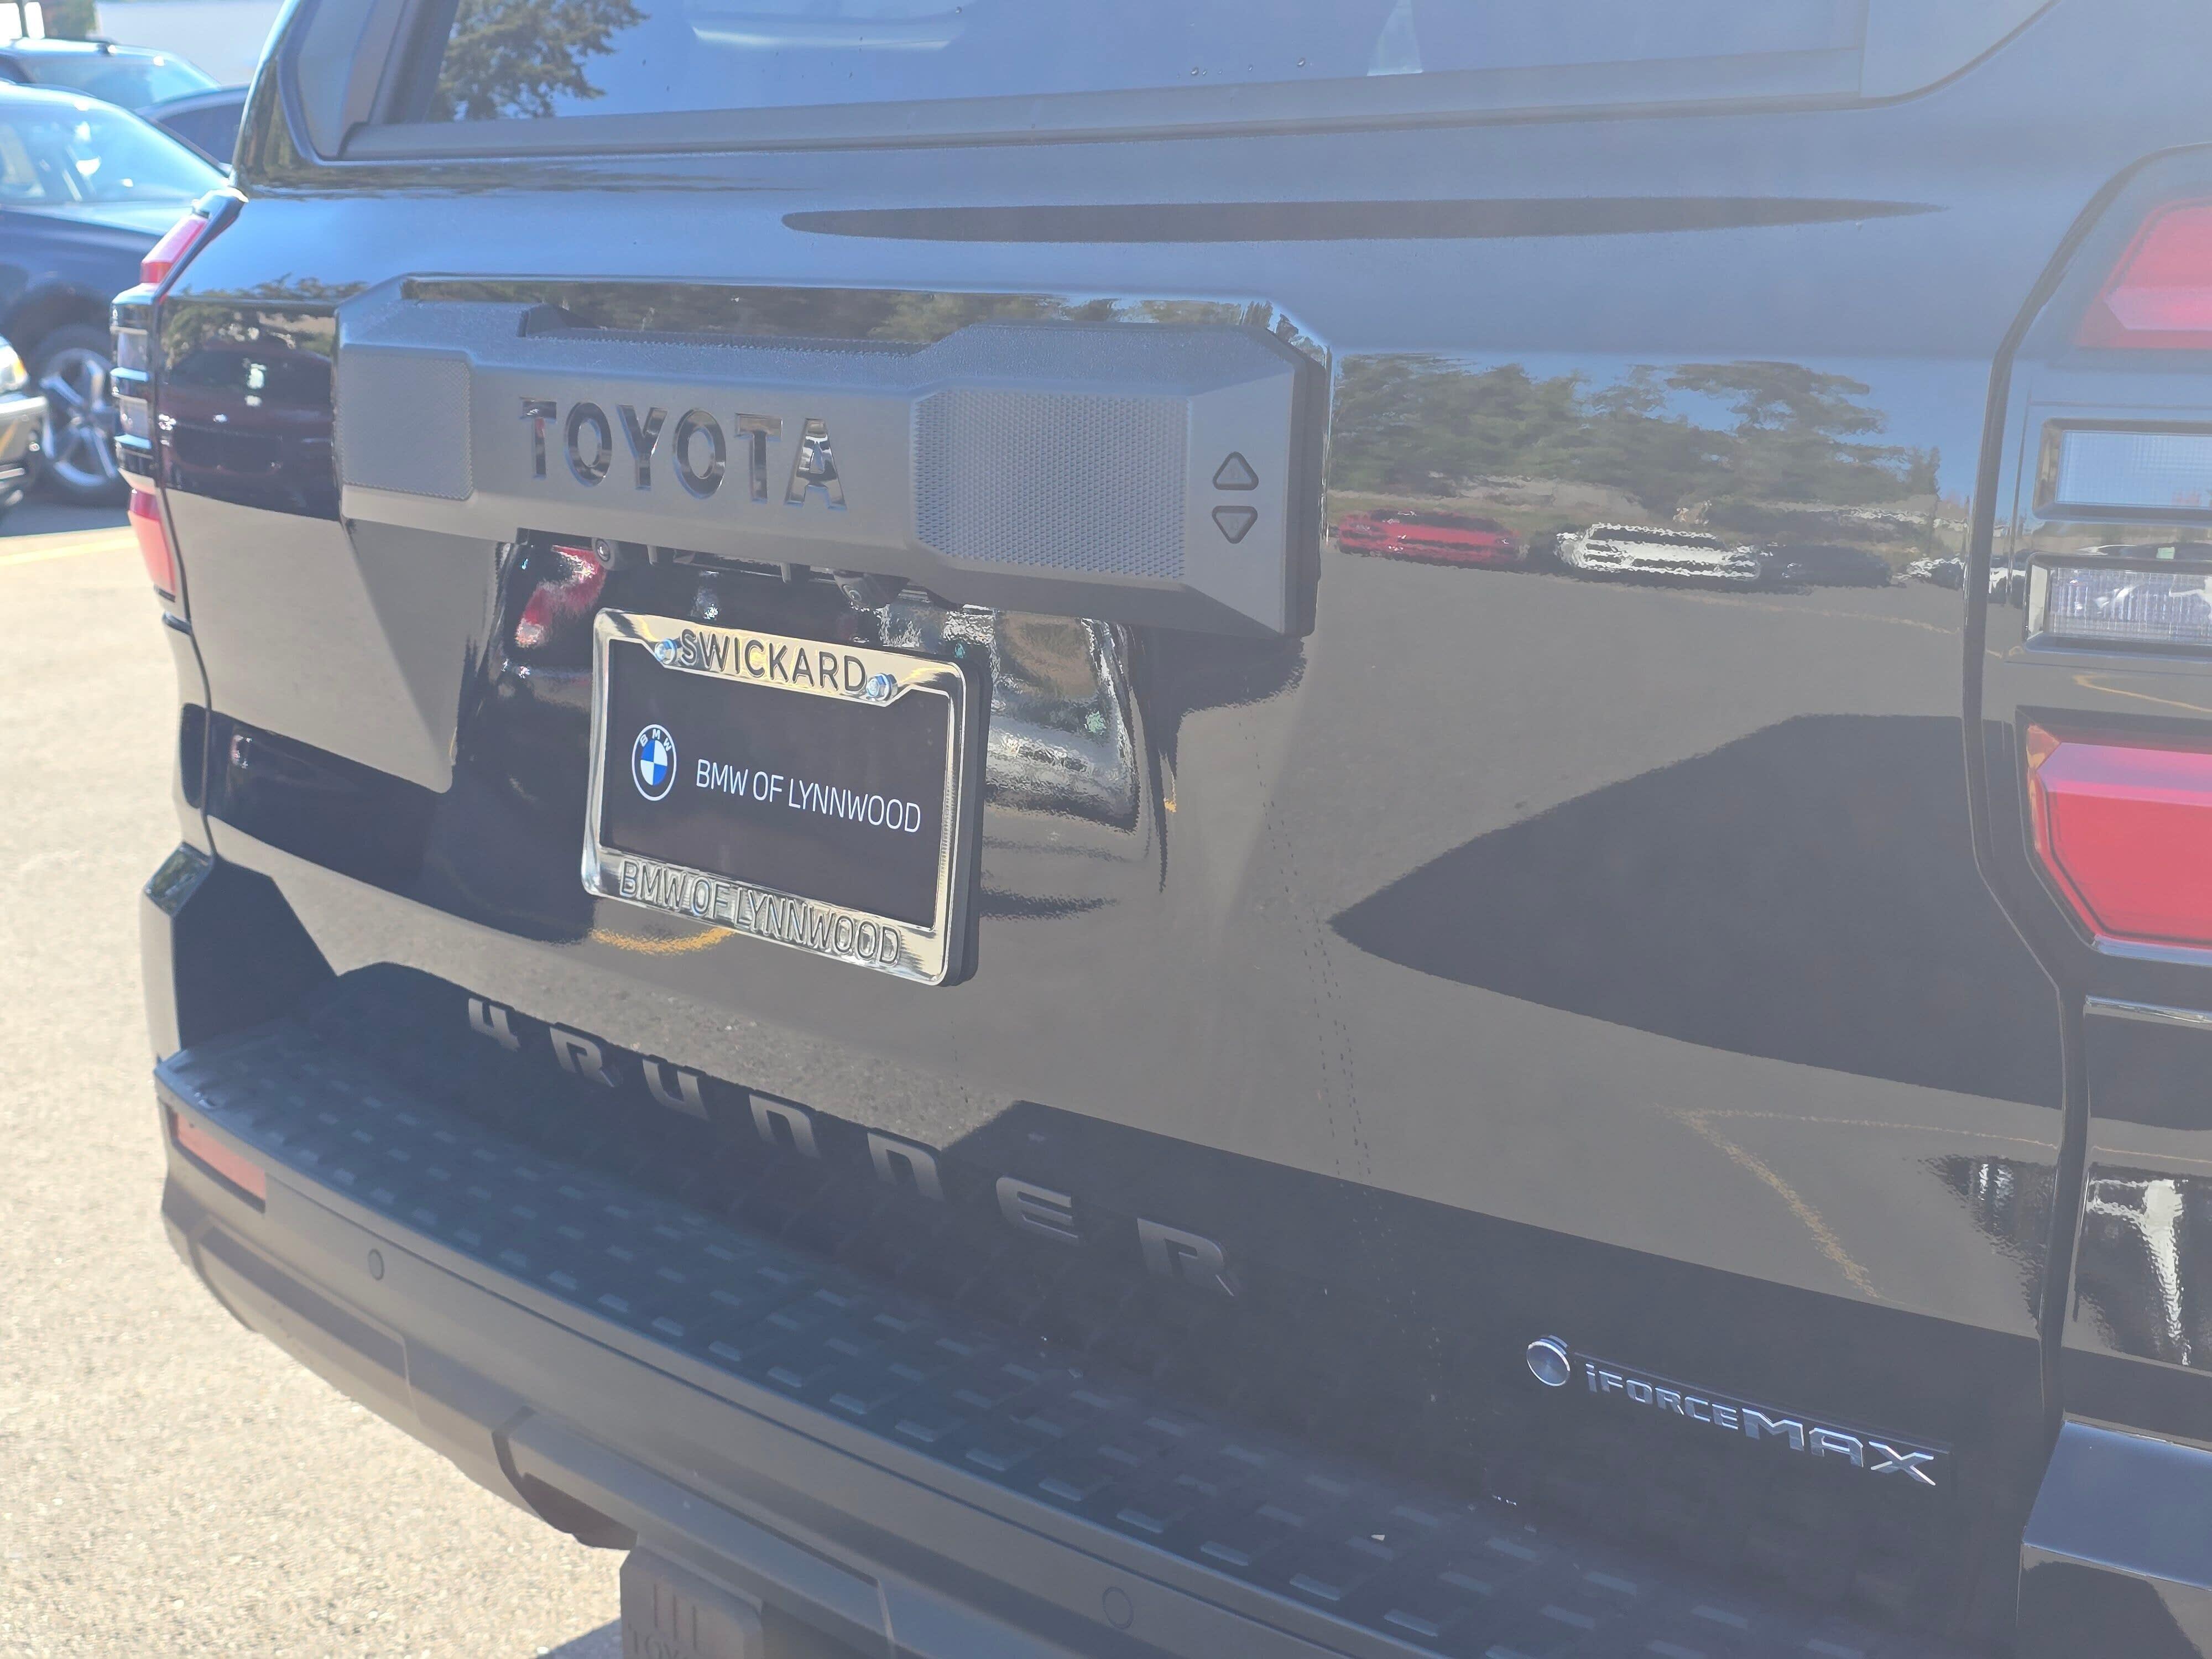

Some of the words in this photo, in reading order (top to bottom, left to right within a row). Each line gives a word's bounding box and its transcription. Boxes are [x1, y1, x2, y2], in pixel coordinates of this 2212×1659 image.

[519, 397, 847, 509] TOYOTA
[681, 629, 867, 692] SWICKARD
[640, 729, 672, 752] BMW
[696, 759, 748, 796] BMW
[753, 771, 784, 802] OF
[789, 778, 921, 833] LYNNWOOD
[620, 858, 687, 911] BMW
[690, 875, 731, 919] OF
[734, 886, 902, 967] LYNNWOOD
[467, 997, 1235, 1297] 4RUNNER
